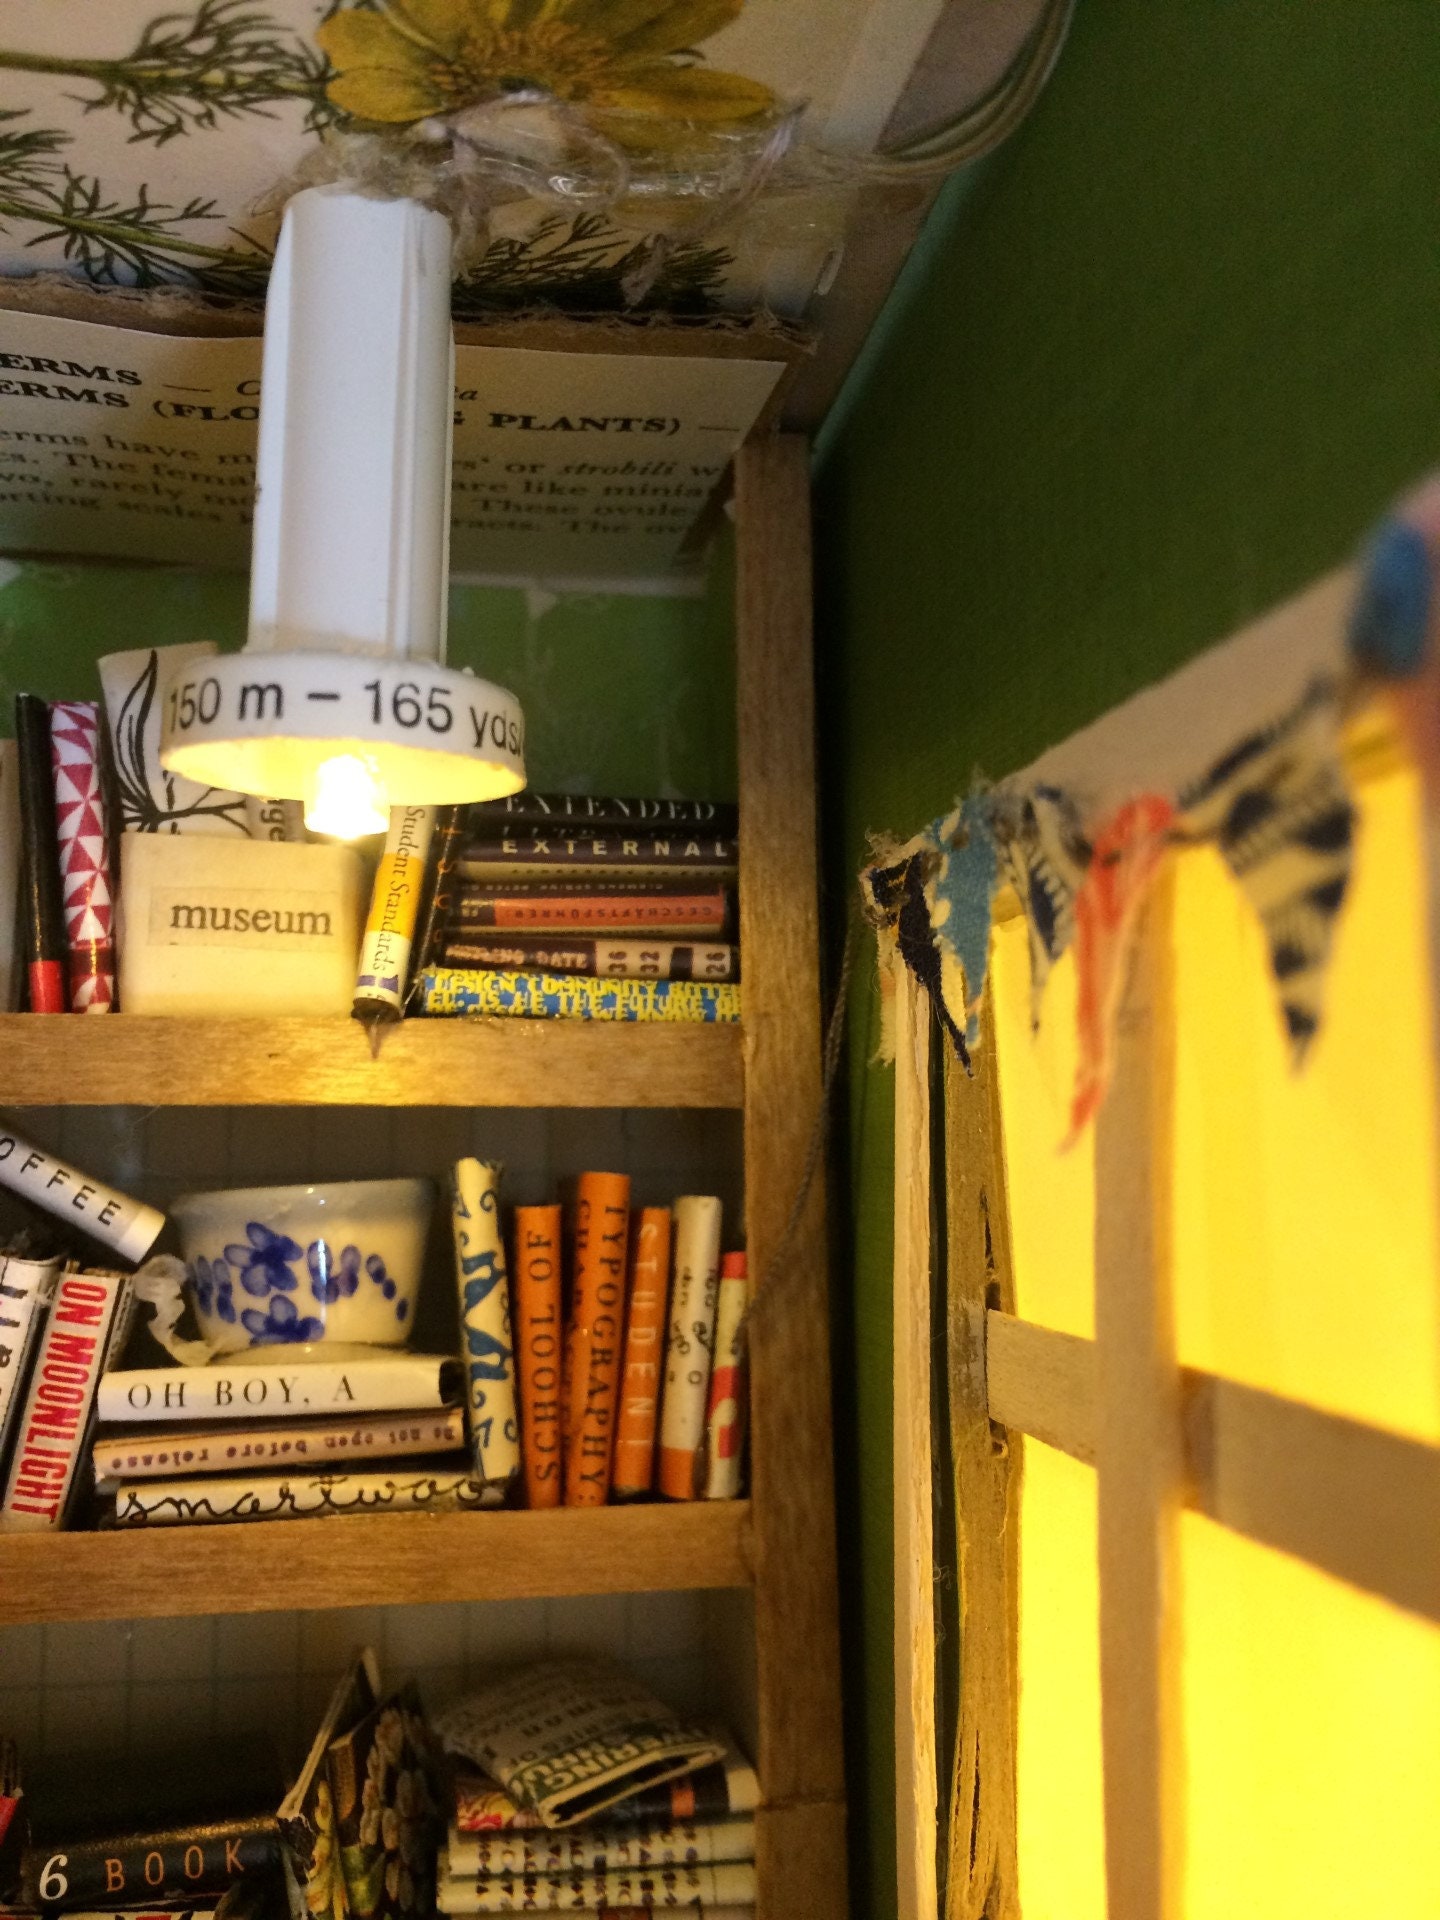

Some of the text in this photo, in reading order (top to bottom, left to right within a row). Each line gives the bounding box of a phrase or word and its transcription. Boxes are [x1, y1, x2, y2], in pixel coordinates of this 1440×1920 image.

[489, 412, 681, 436] PLANTS)
[102, 434, 200, 459] have
[168, 677, 221, 735] 150
[237, 681, 284, 721] m
[364, 678, 453, 734] 165
[502, 839, 728, 857] EXTERNAL
[372, 806, 426, 971] Student Standards
[169, 903, 332, 936] museum
[527, 1230, 559, 1482] SCHOOL OF
[11, 1280, 109, 1525] ON MOONLIGHT
[127, 1375, 358, 1409] OH BOY, A
[111, 1447, 210, 1470] release
[226, 1442, 308, 1460] before
[38, 1838, 245, 1900] 6 BOOK
